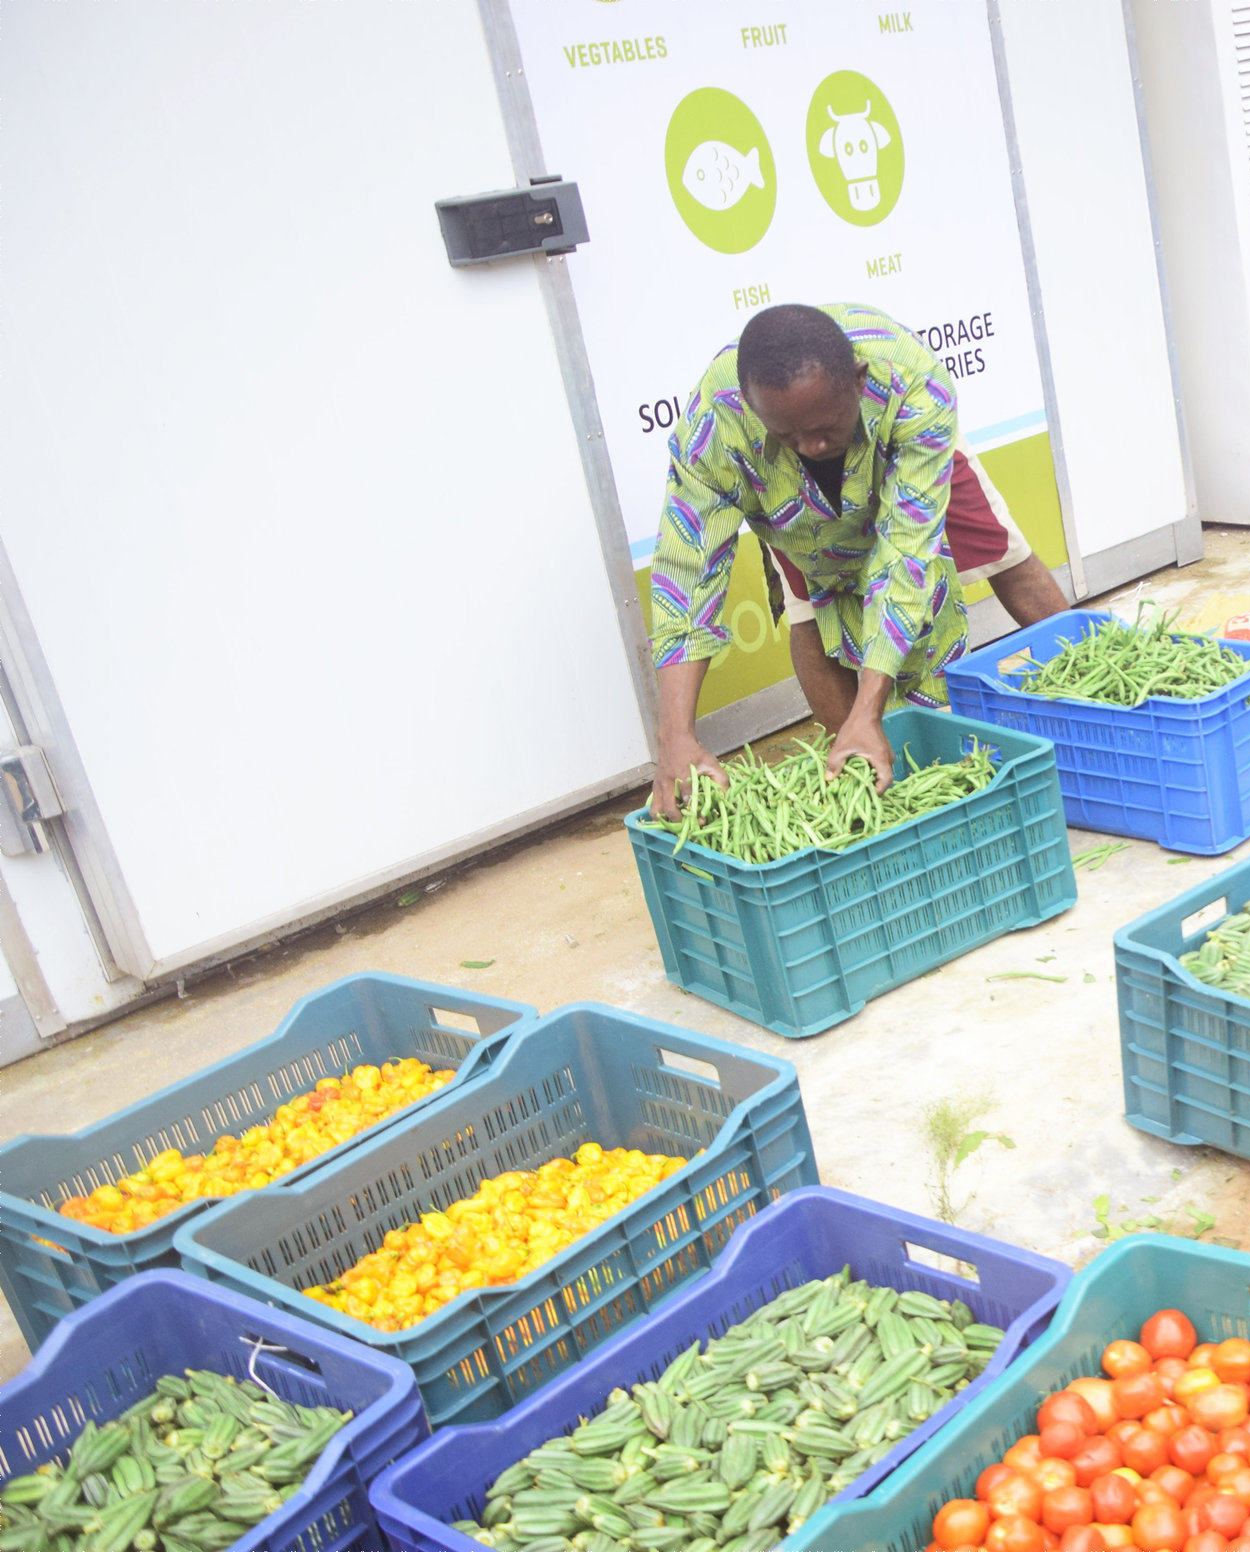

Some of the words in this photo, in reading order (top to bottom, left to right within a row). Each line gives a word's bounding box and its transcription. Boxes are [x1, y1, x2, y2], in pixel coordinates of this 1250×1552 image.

[740, 24, 787, 48] FRUIT
[878, 12, 914, 34] MILK
[562, 36, 668, 68] VEGTABLES
[866, 253, 902, 279] MEAT
[732, 283, 771, 310] FISH
[941, 347, 986, 379] RIES
